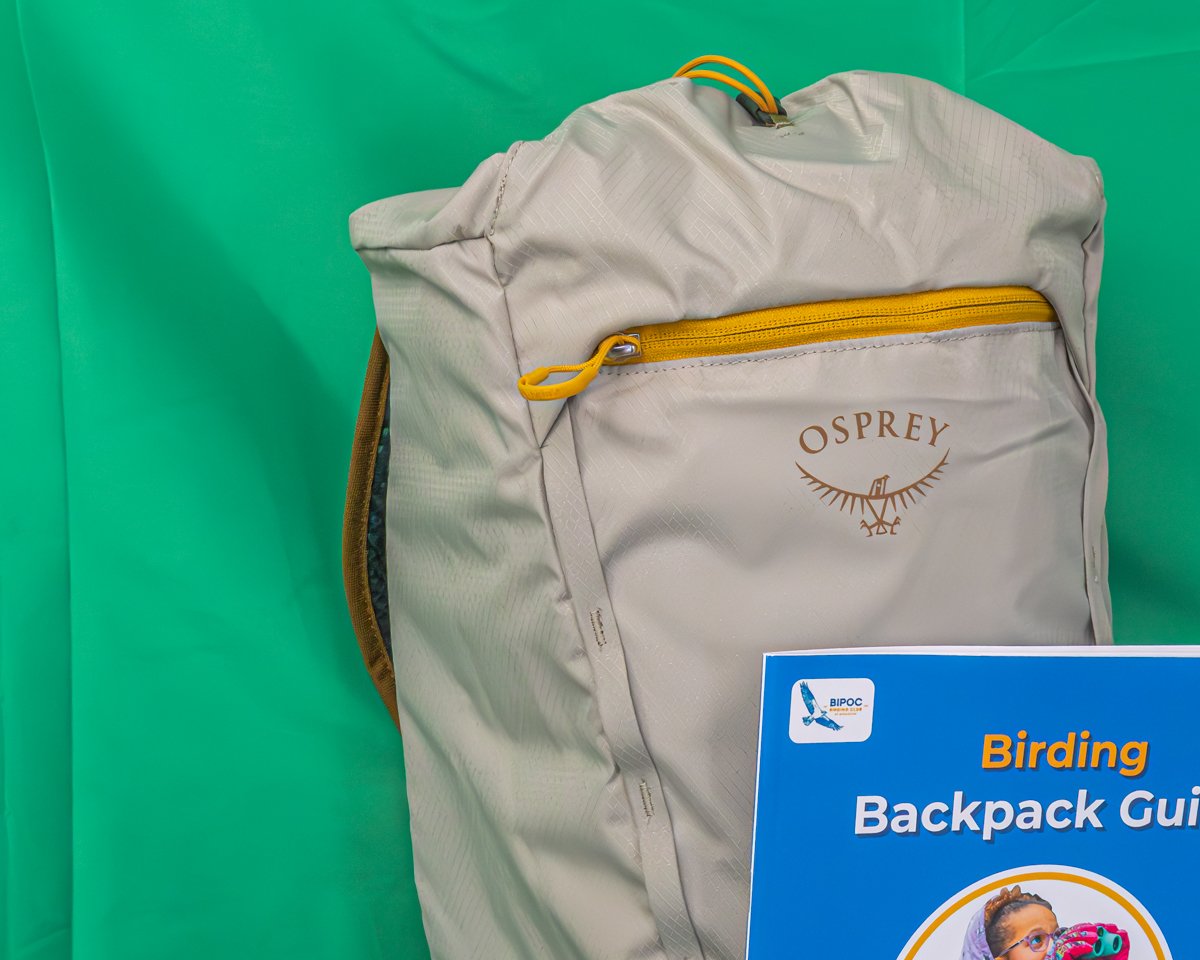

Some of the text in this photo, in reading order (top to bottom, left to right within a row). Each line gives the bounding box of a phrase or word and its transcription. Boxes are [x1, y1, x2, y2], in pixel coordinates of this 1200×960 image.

[799, 410, 950, 454] OSPREY
[830, 698, 862, 707] BIPOC
[981, 730, 1149, 777] Birding
[854, 789, 1105, 841] Backpack
